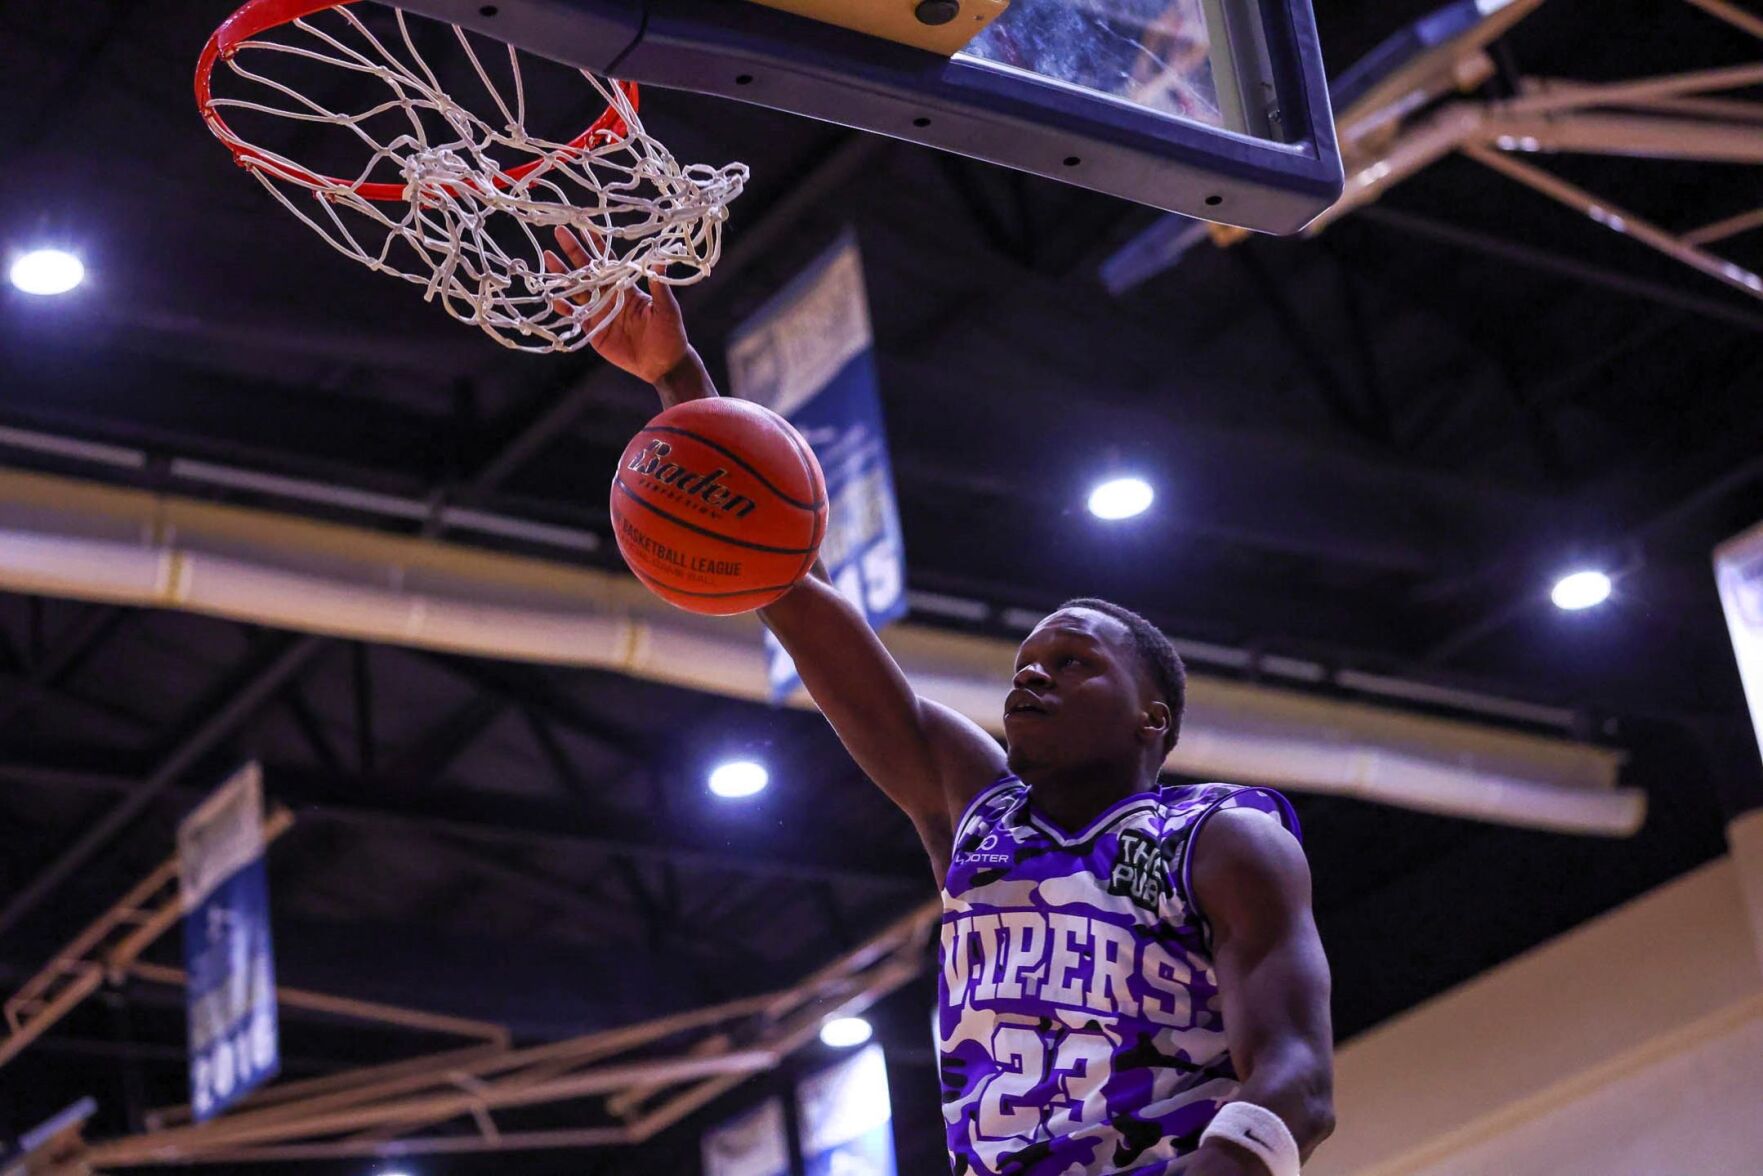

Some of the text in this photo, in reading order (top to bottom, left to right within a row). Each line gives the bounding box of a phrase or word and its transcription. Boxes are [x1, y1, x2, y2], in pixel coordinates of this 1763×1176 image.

[628, 439, 755, 517] Baden
[623, 519, 687, 568] BASKETBALL
[692, 557, 741, 576] LEAGUE
[942, 912, 1192, 1027] VIPERS
[978, 1027, 1112, 1142] 23
